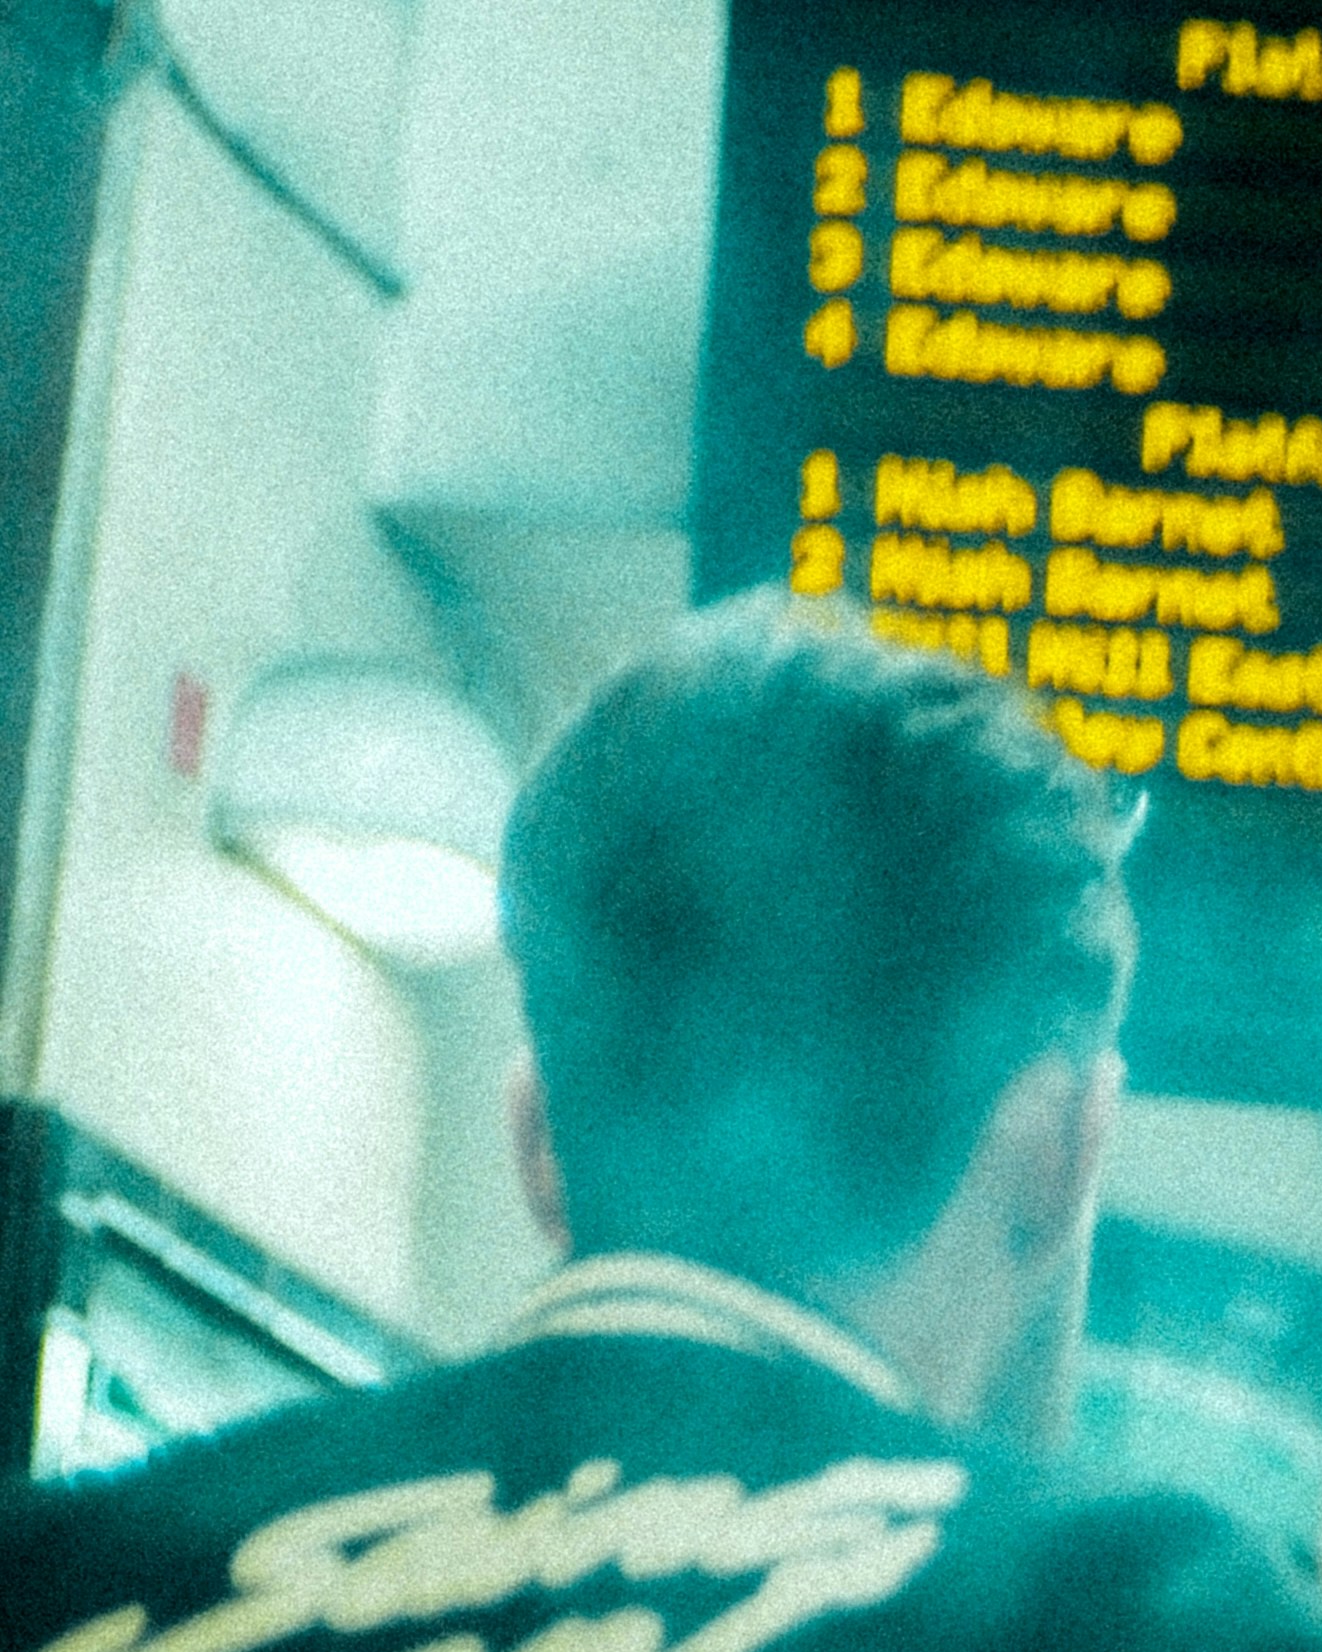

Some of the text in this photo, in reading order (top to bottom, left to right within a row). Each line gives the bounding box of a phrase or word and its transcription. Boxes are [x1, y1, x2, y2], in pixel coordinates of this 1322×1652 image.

[822, 65, 868, 141] 1
[896, 69, 1186, 168] Edgware
[810, 141, 871, 219] 2
[891, 146, 1180, 245] Edgware
[806, 216, 867, 295] 3
[885, 223, 1175, 322] Edgware
[801, 296, 861, 370] 4
[881, 300, 1169, 397] Edgware
[797, 447, 844, 523] 1
[871, 452, 1041, 540] High
[1046, 465, 1288, 563] Barnet
[787, 520, 848, 596] 2
[866, 529, 1036, 616] High
[1040, 543, 1283, 637] Barnet
[1022, 615, 1177, 703] Hill
